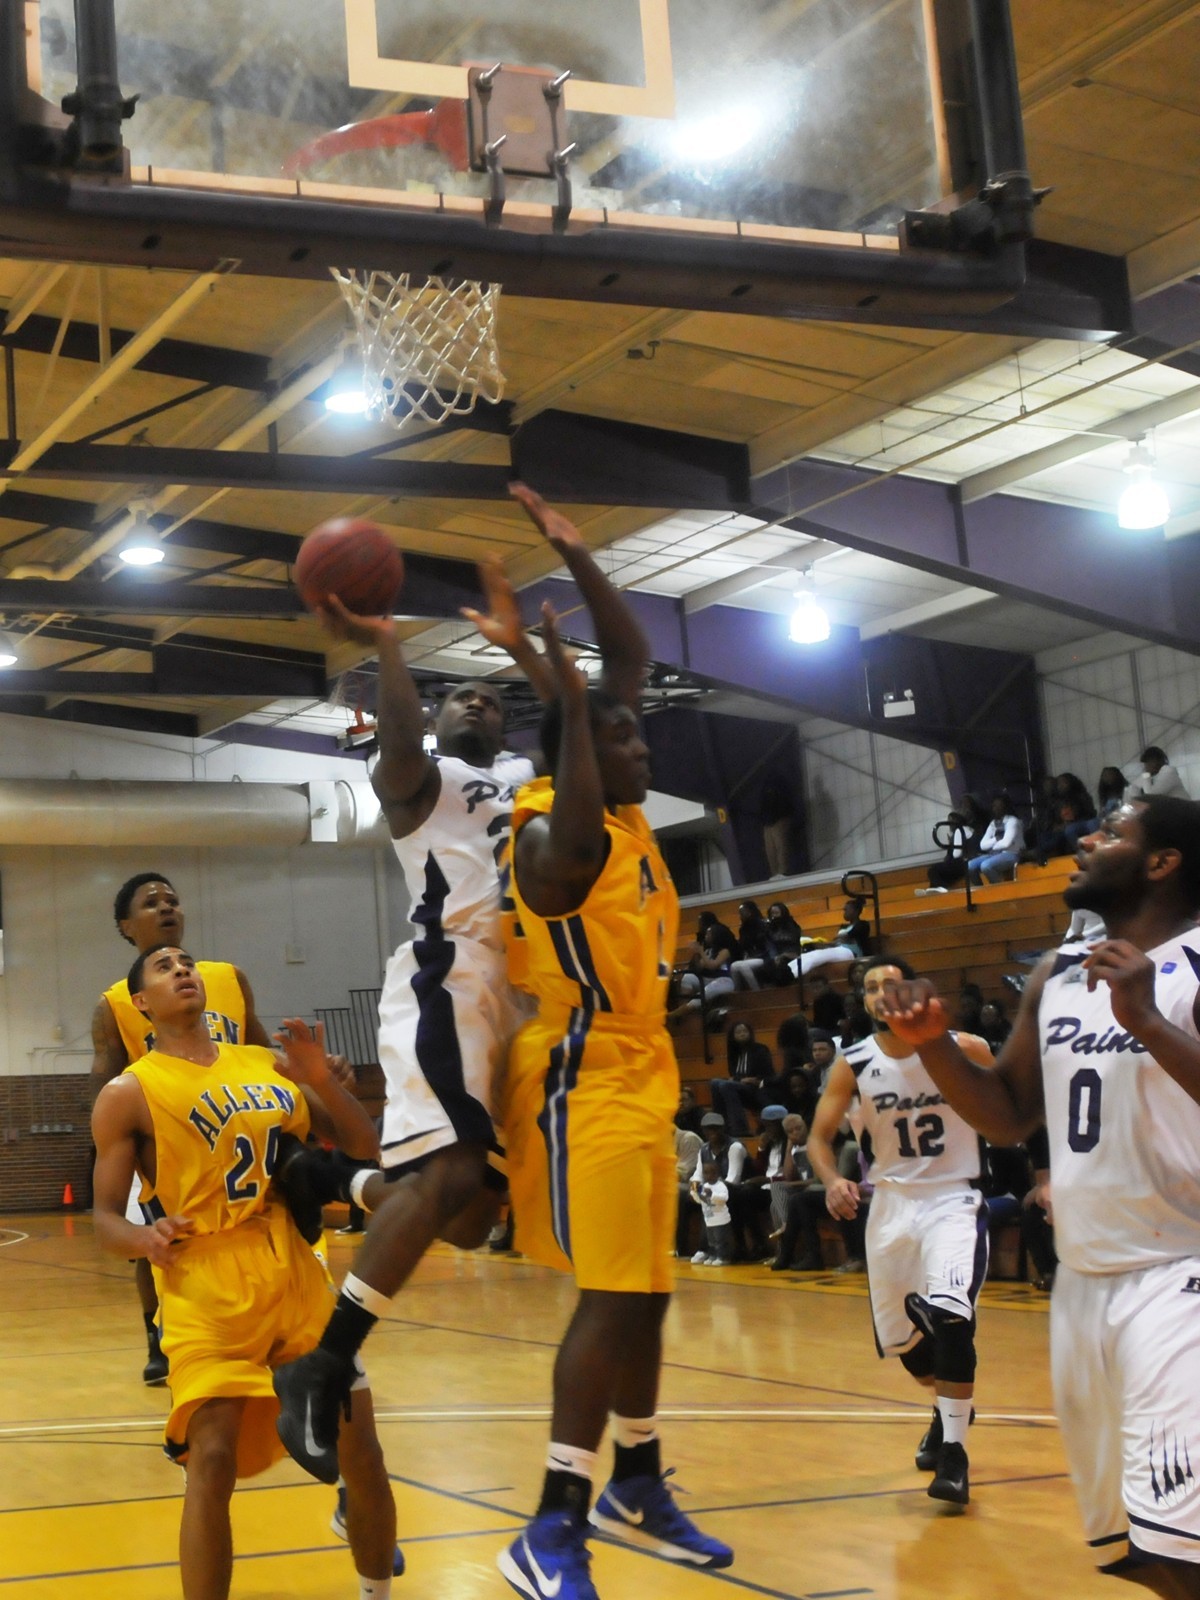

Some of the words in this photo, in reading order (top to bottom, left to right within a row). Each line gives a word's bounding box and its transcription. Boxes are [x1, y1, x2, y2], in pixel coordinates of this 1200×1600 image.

[187, 1084, 297, 1153] ALLEN
[894, 1113, 945, 1158] 12
[1067, 1067, 1103, 1153] 0
